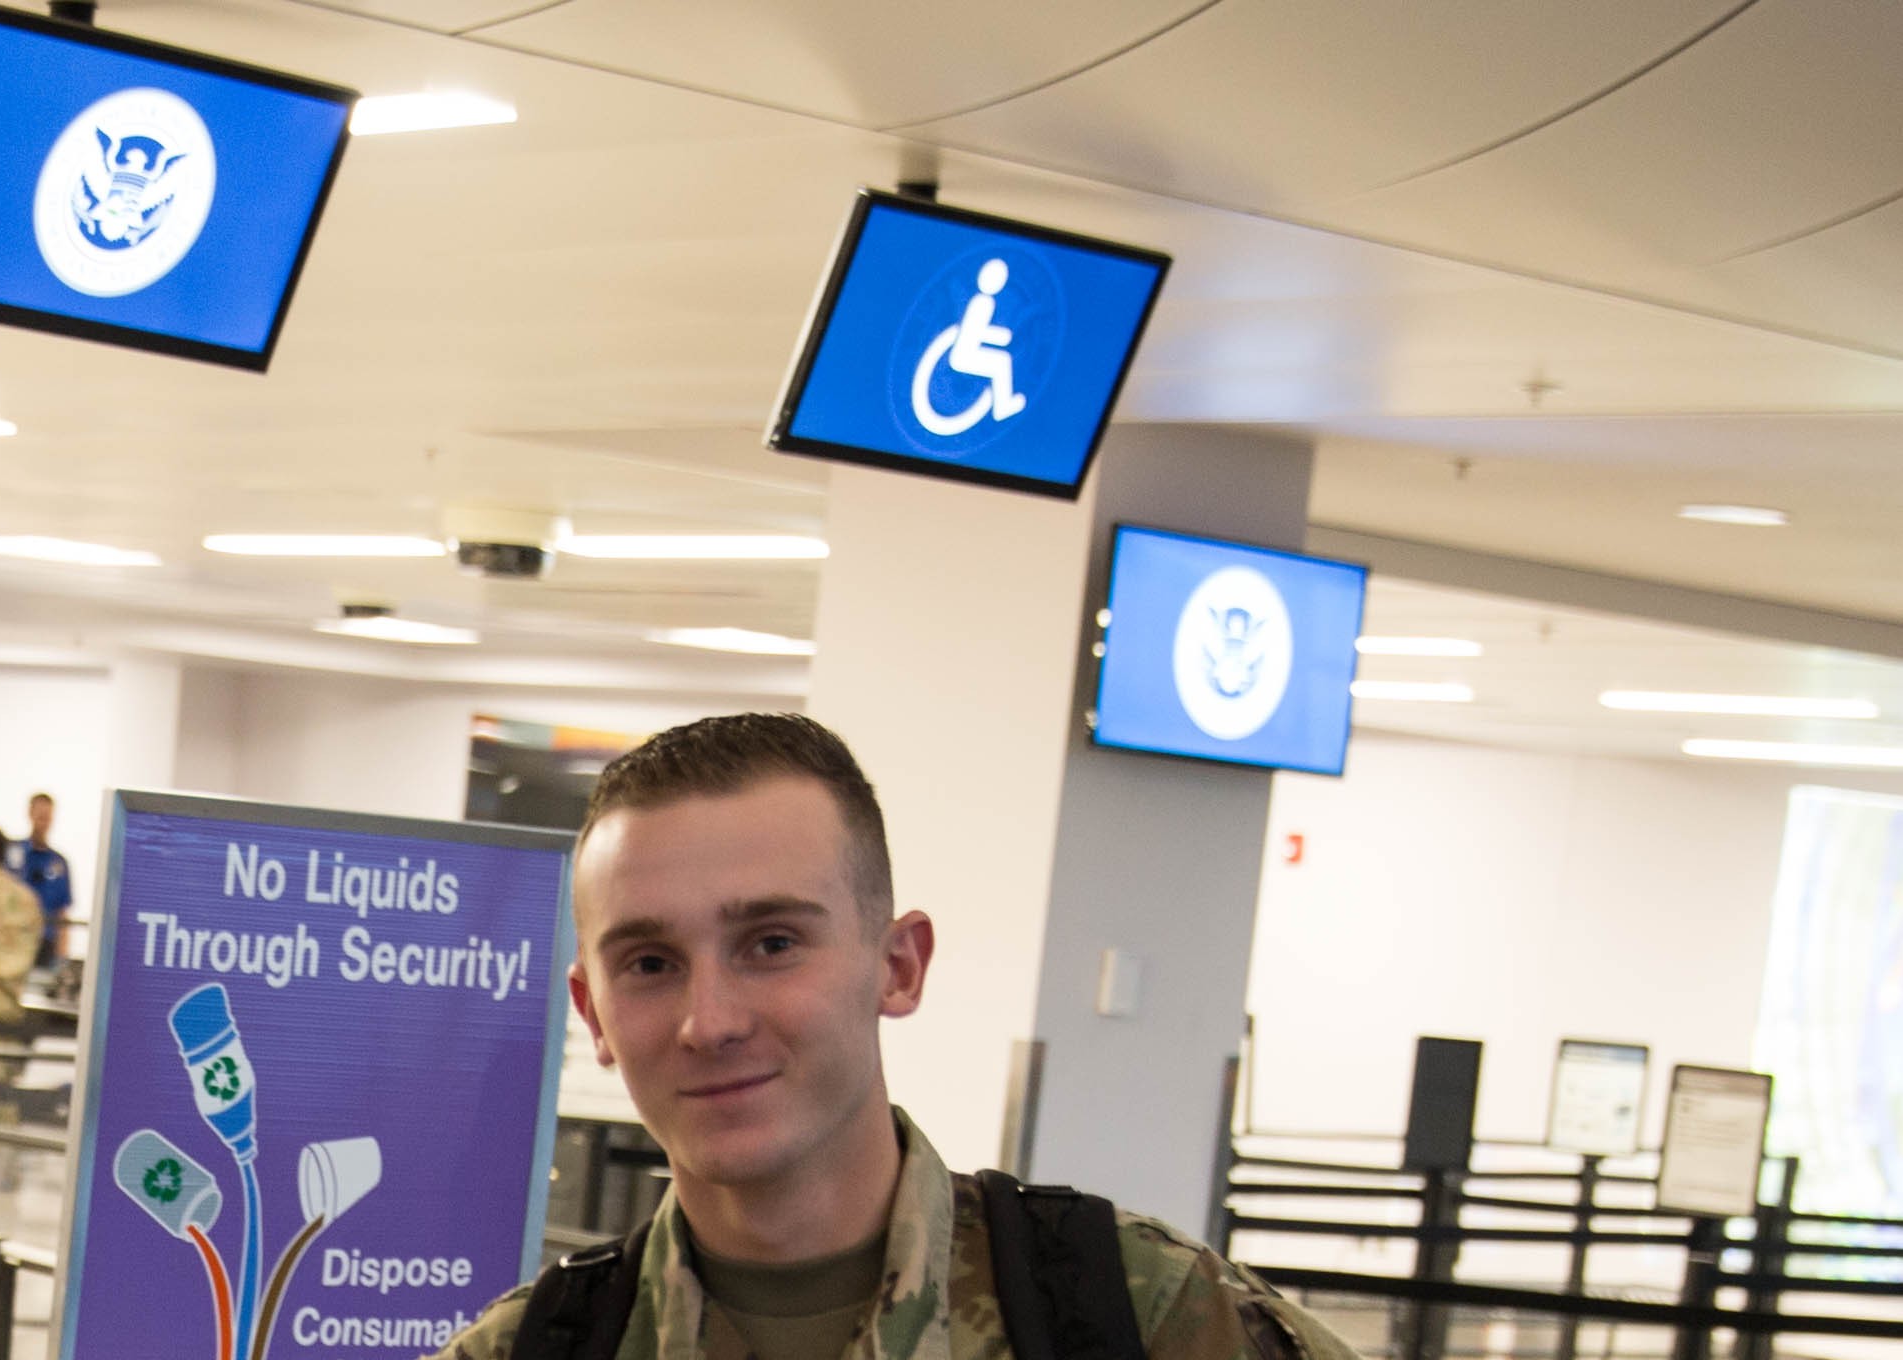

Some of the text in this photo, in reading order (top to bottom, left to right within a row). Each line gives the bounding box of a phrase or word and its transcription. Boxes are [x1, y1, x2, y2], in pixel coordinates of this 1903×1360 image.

[224, 842, 459, 919] No Liquids
[136, 911, 531, 1001] Through Security!
[321, 1248, 473, 1295] Dispose
